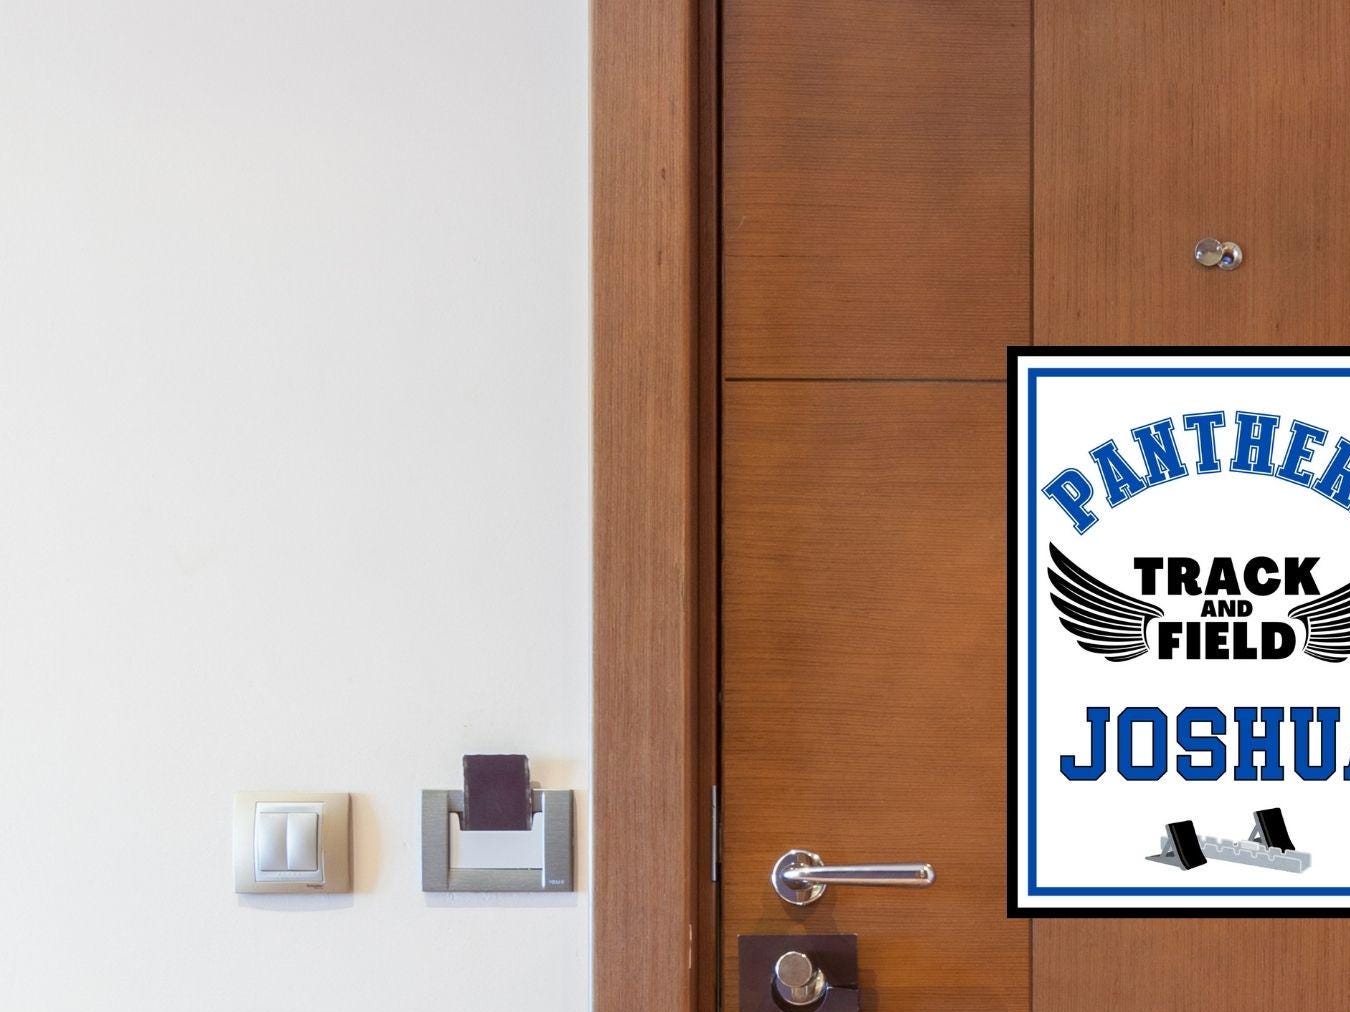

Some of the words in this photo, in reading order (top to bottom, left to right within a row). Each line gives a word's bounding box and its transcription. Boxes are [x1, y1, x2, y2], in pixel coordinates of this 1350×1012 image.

[1133, 556, 1321, 596] TRACK
[1200, 599, 1254, 618] AND
[1157, 621, 1297, 660] FIELD
